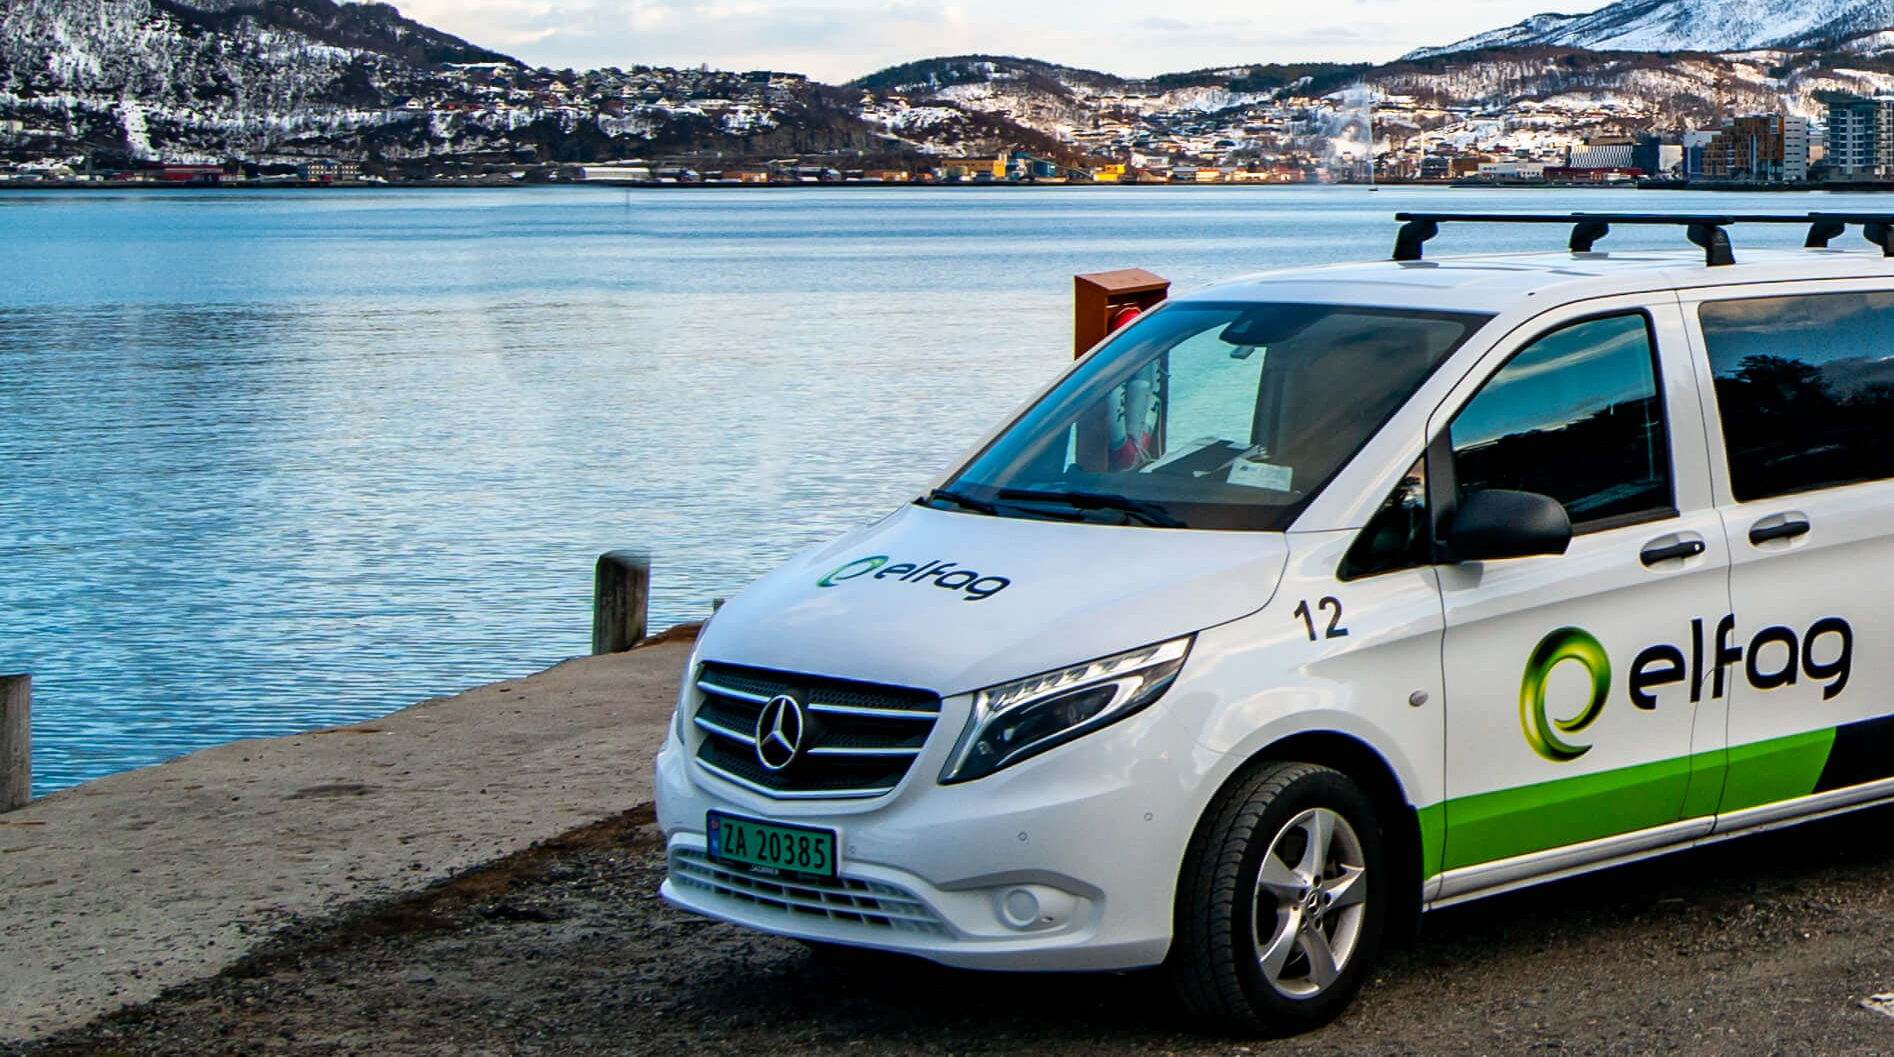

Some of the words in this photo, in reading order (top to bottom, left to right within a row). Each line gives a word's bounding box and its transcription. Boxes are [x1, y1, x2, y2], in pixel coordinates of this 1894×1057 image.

[873, 559, 1011, 601] elfag
[1293, 595, 1349, 642] 12
[1629, 613, 1854, 710] elfag
[723, 822, 747, 858] ZA
[756, 829, 826, 869] 20385
